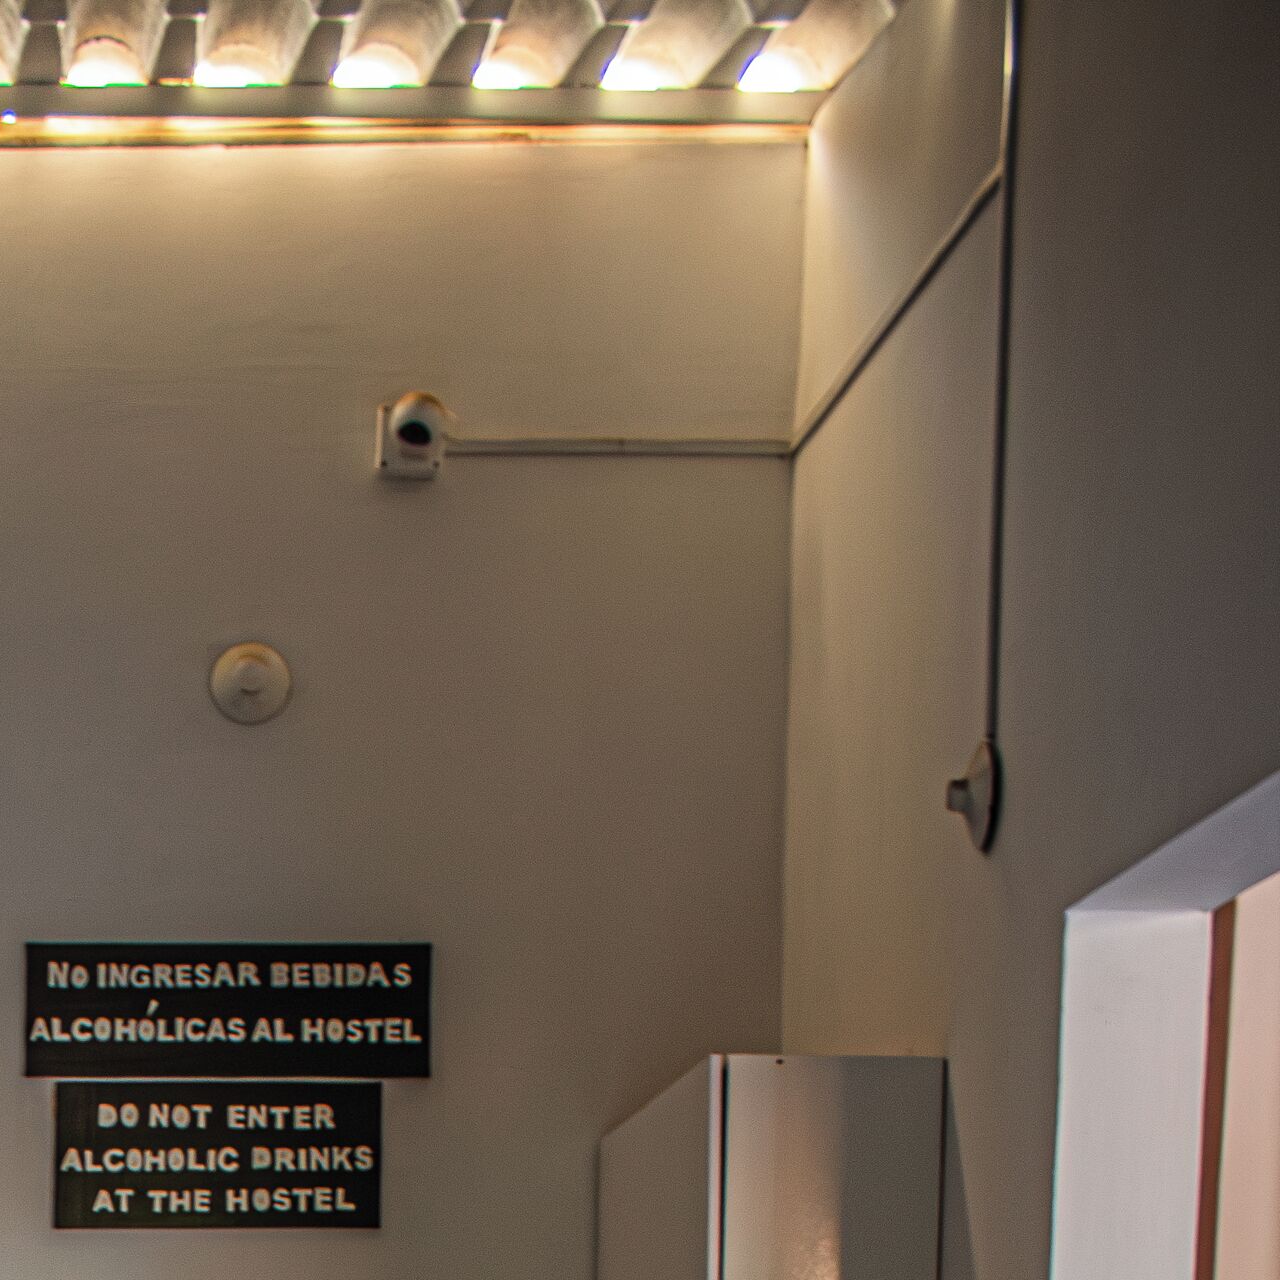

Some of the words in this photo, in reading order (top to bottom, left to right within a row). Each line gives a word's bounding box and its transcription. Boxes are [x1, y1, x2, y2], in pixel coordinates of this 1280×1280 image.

[98, 962, 260, 988] INGRESAR
[272, 962, 411, 986] BEBIDAS
[31, 1000, 246, 1042] ALCOHÓLICAS
[252, 1018, 294, 1041] AL
[302, 1018, 421, 1042] HOSTEL
[98, 1103, 139, 1127] DO
[149, 1104, 212, 1128] NOT
[228, 1104, 335, 1129] ENTER
[61, 1147, 239, 1172] ALCOHOLIC
[252, 1146, 372, 1171] DRINKS
[93, 1188, 134, 1212] AT
[148, 1189, 211, 1212] THE
[226, 1187, 355, 1212] HOSTEL
